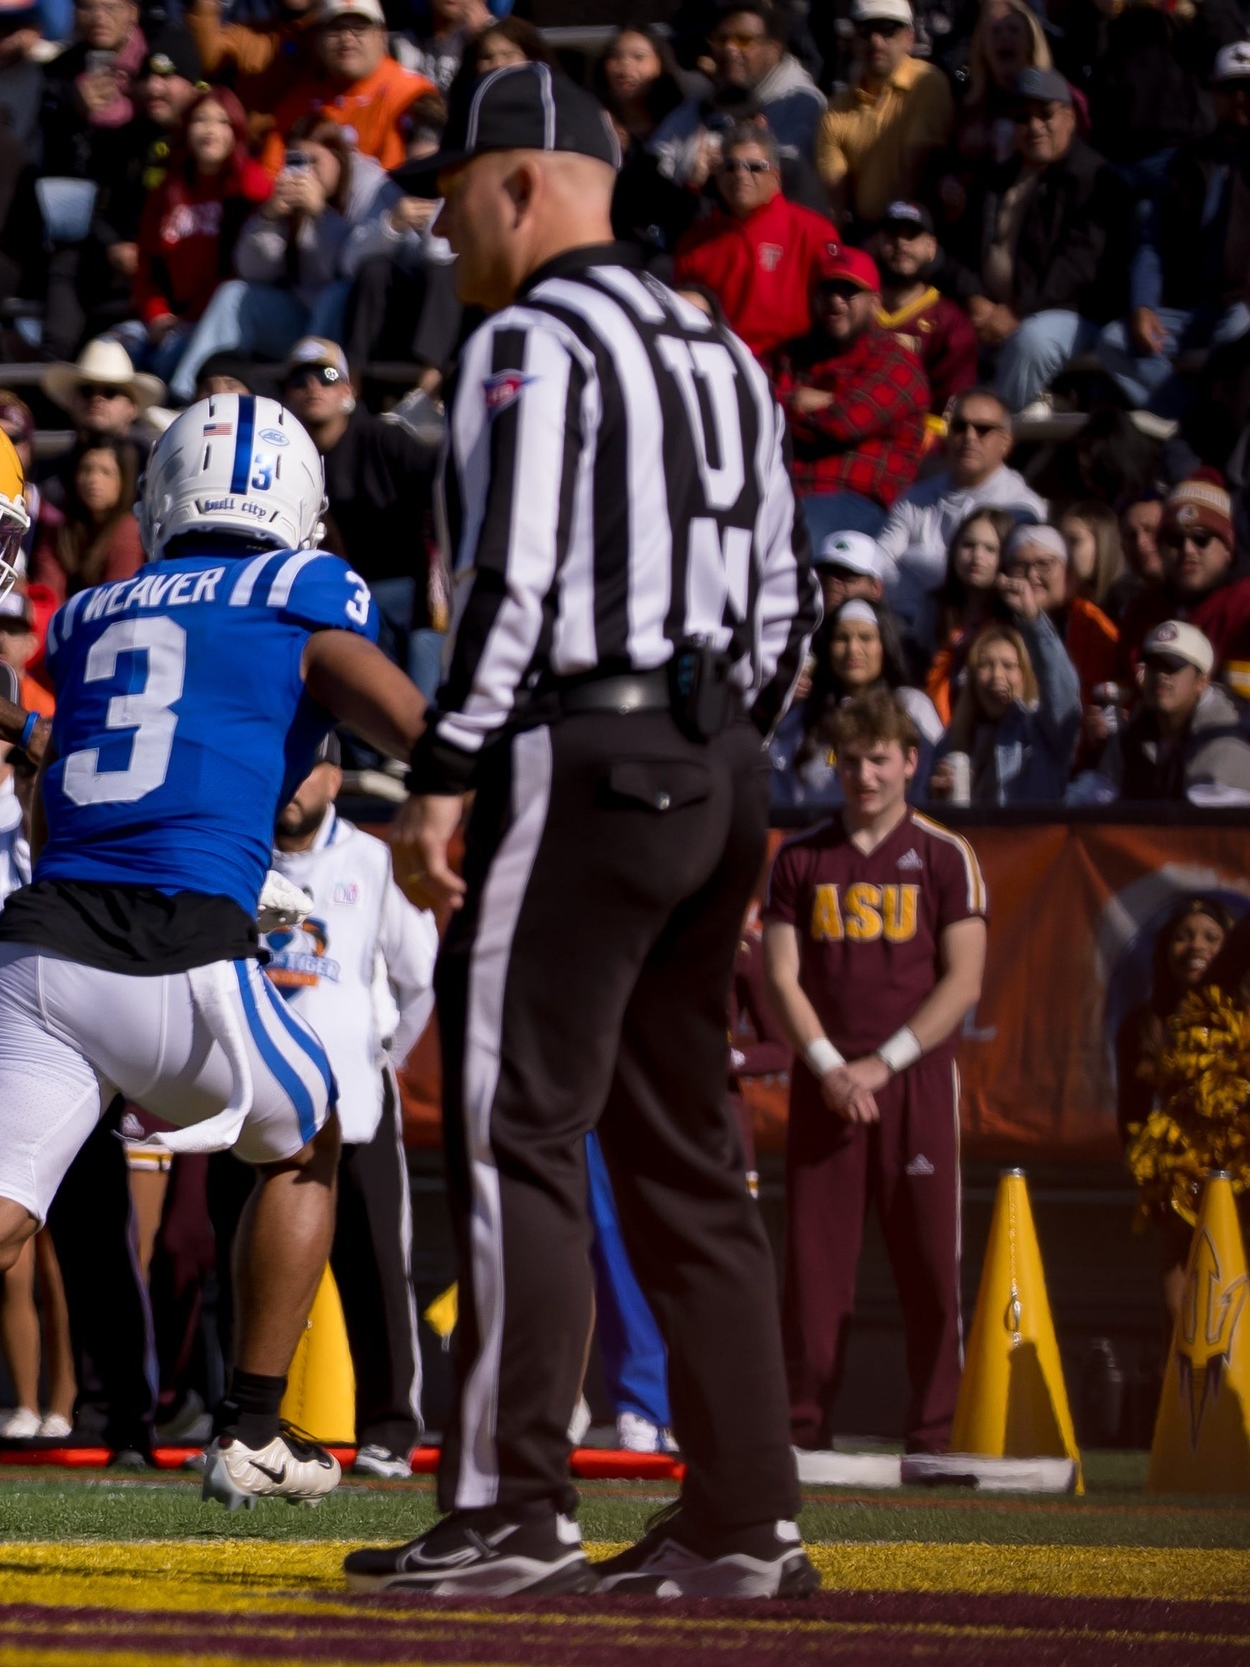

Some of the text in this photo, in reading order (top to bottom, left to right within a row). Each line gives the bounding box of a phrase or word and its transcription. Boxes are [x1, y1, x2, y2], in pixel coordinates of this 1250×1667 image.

[251, 453, 273, 491] 3
[241, 501, 267, 522] city
[82, 566, 226, 623] WEAVER
[344, 571, 371, 626] 3
[63, 615, 187, 806] 3
[812, 882, 921, 943] ASU
